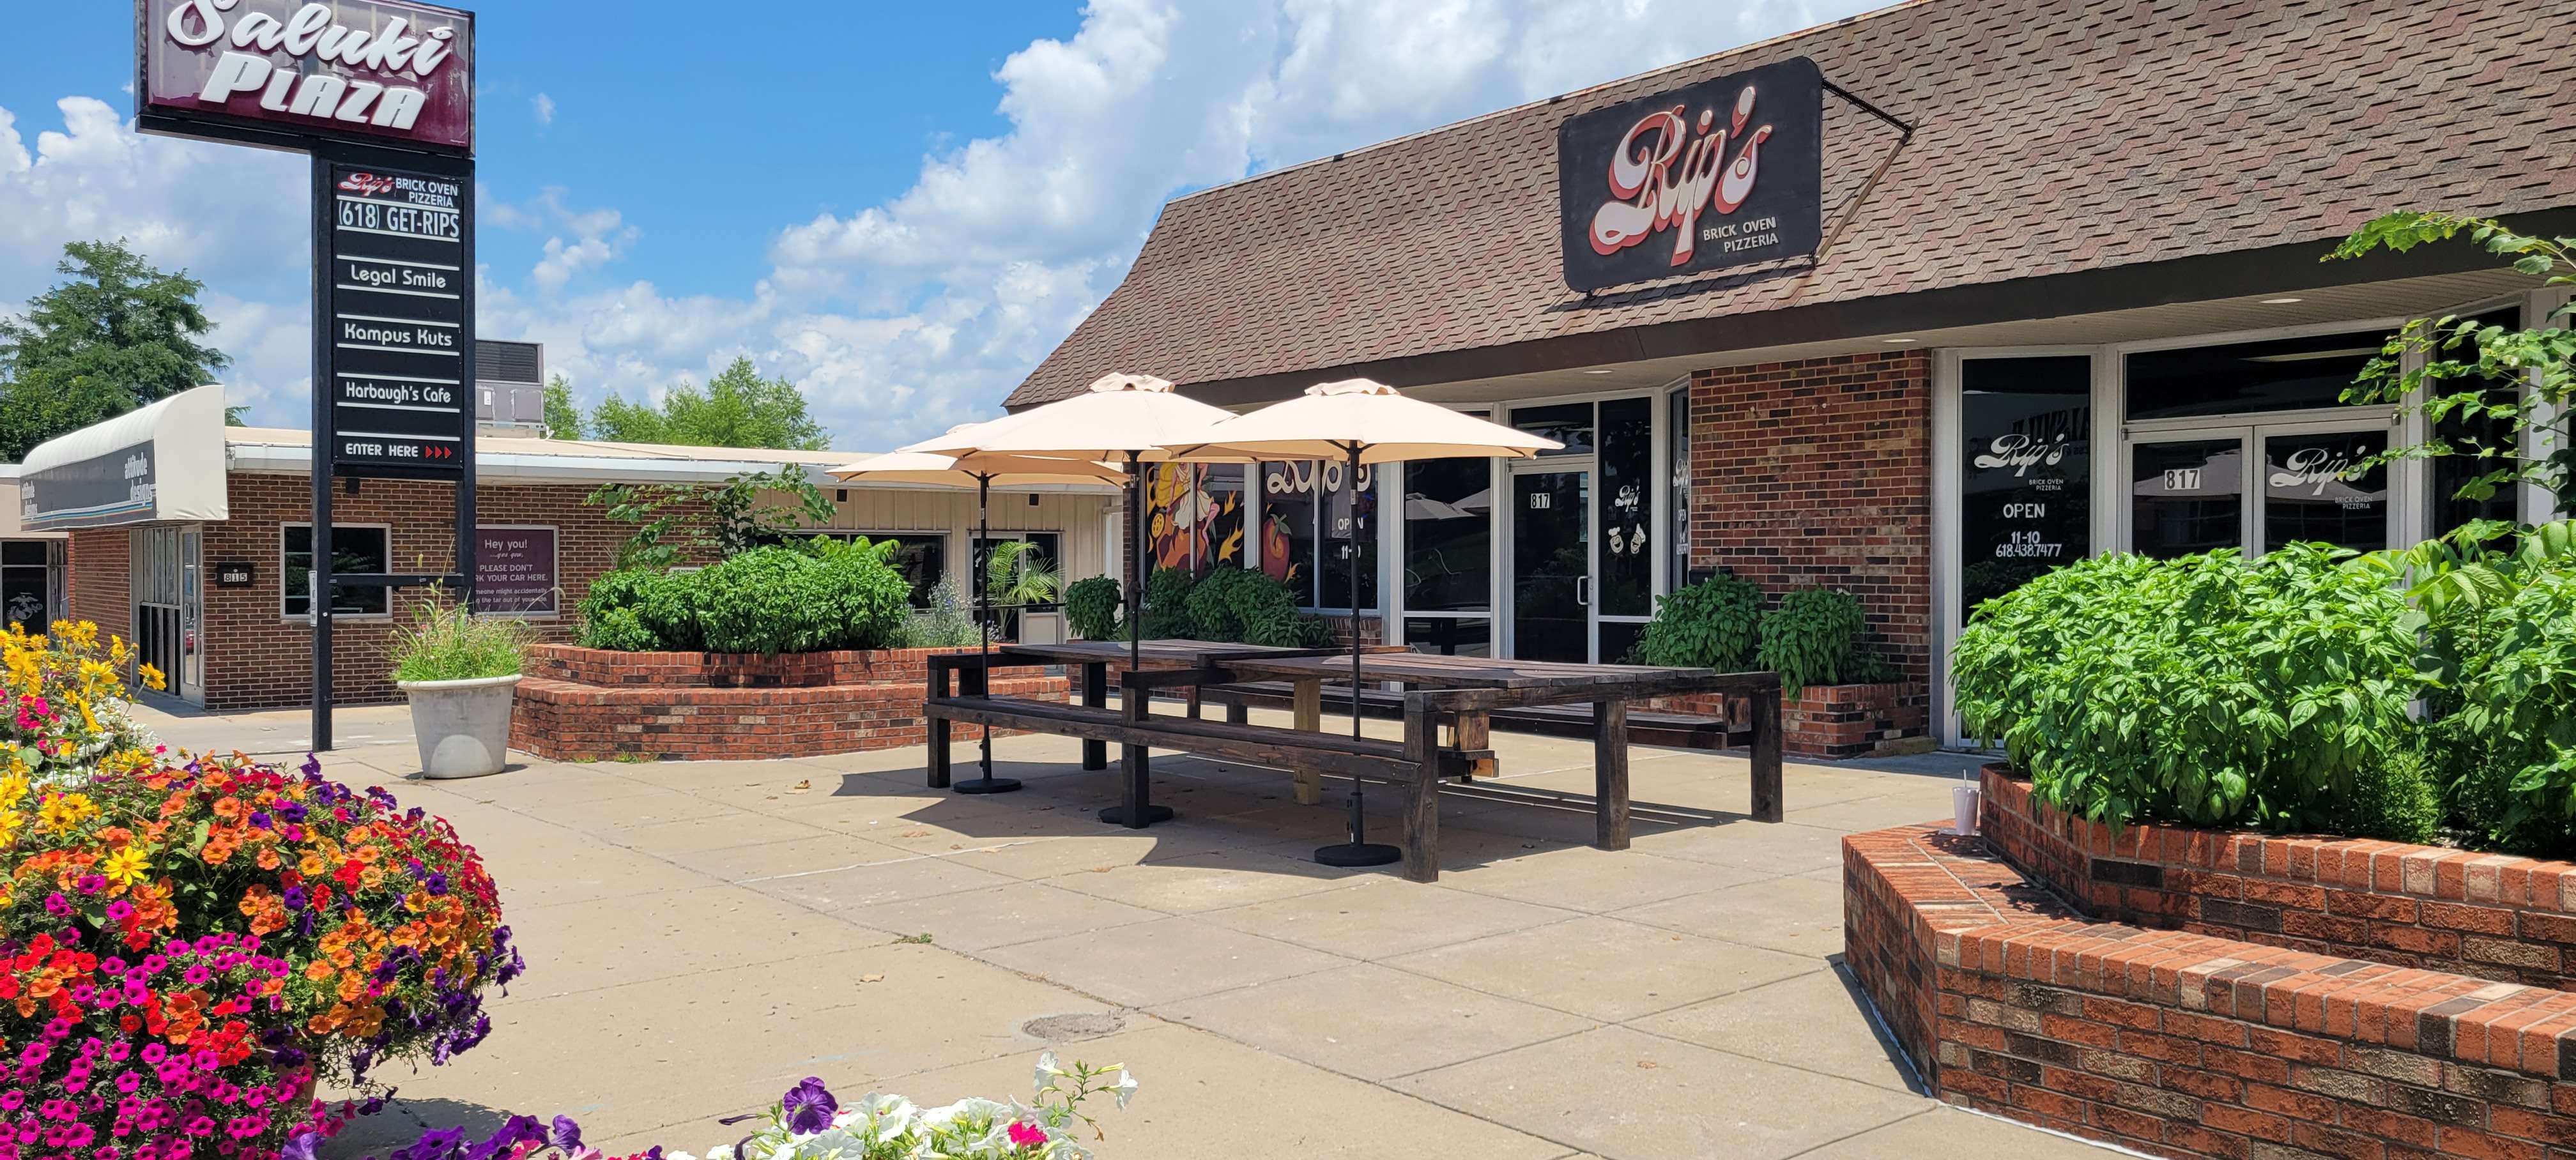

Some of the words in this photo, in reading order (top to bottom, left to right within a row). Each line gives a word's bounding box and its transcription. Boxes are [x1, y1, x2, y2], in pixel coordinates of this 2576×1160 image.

[167, 0, 454, 76] Saluki
[199, 50, 426, 130] PLAZA
[337, 172, 395, 197] Rip's
[1589, 86, 1773, 266] Rip's
[396, 178, 426, 192] BRICK
[429, 181, 458, 196] OVEN
[409, 192, 454, 208] PIZZERIA
[339, 201, 380, 229] (618)
[387, 207, 459, 238] GET-RIPS
[1703, 224, 1737, 241] BRICK
[1743, 217, 1777, 233] OVEN
[1724, 233, 1779, 253] PIZZERIA
[351, 264, 396, 286] Legal
[402, 270, 446, 288] Smile
[345, 323, 411, 345] Kampus
[417, 328, 452, 346] Kuts
[346, 381, 419, 404] Harbaugh's
[423, 387, 451, 403] Cafe
[346, 443, 382, 456] ENTER
[388, 445, 418, 457] HERE
[1974, 433, 2069, 477] Rip's
[2166, 470, 2198, 490] 817
[1531, 494, 1549, 508] 817
[2003, 503, 2045, 519] OPEN
[1338, 517, 1364, 531] OPN
[484, 539, 503, 551] Hey
[507, 539, 528, 551] you!
[2011, 531, 2041, 544] 11-10
